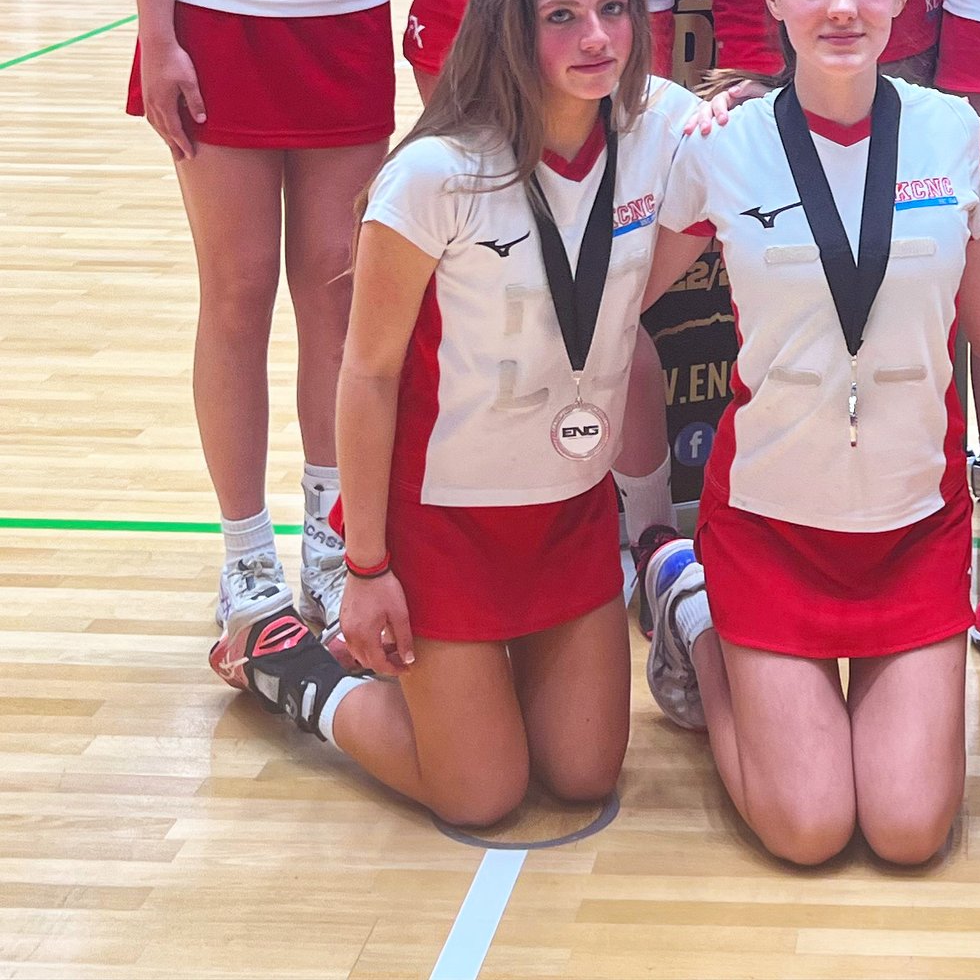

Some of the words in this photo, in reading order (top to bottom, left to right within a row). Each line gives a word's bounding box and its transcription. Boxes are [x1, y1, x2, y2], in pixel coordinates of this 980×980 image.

[895, 176, 954, 202] KCNC
[613, 193, 655, 228] CNC
[561, 424, 600, 439] ENG
